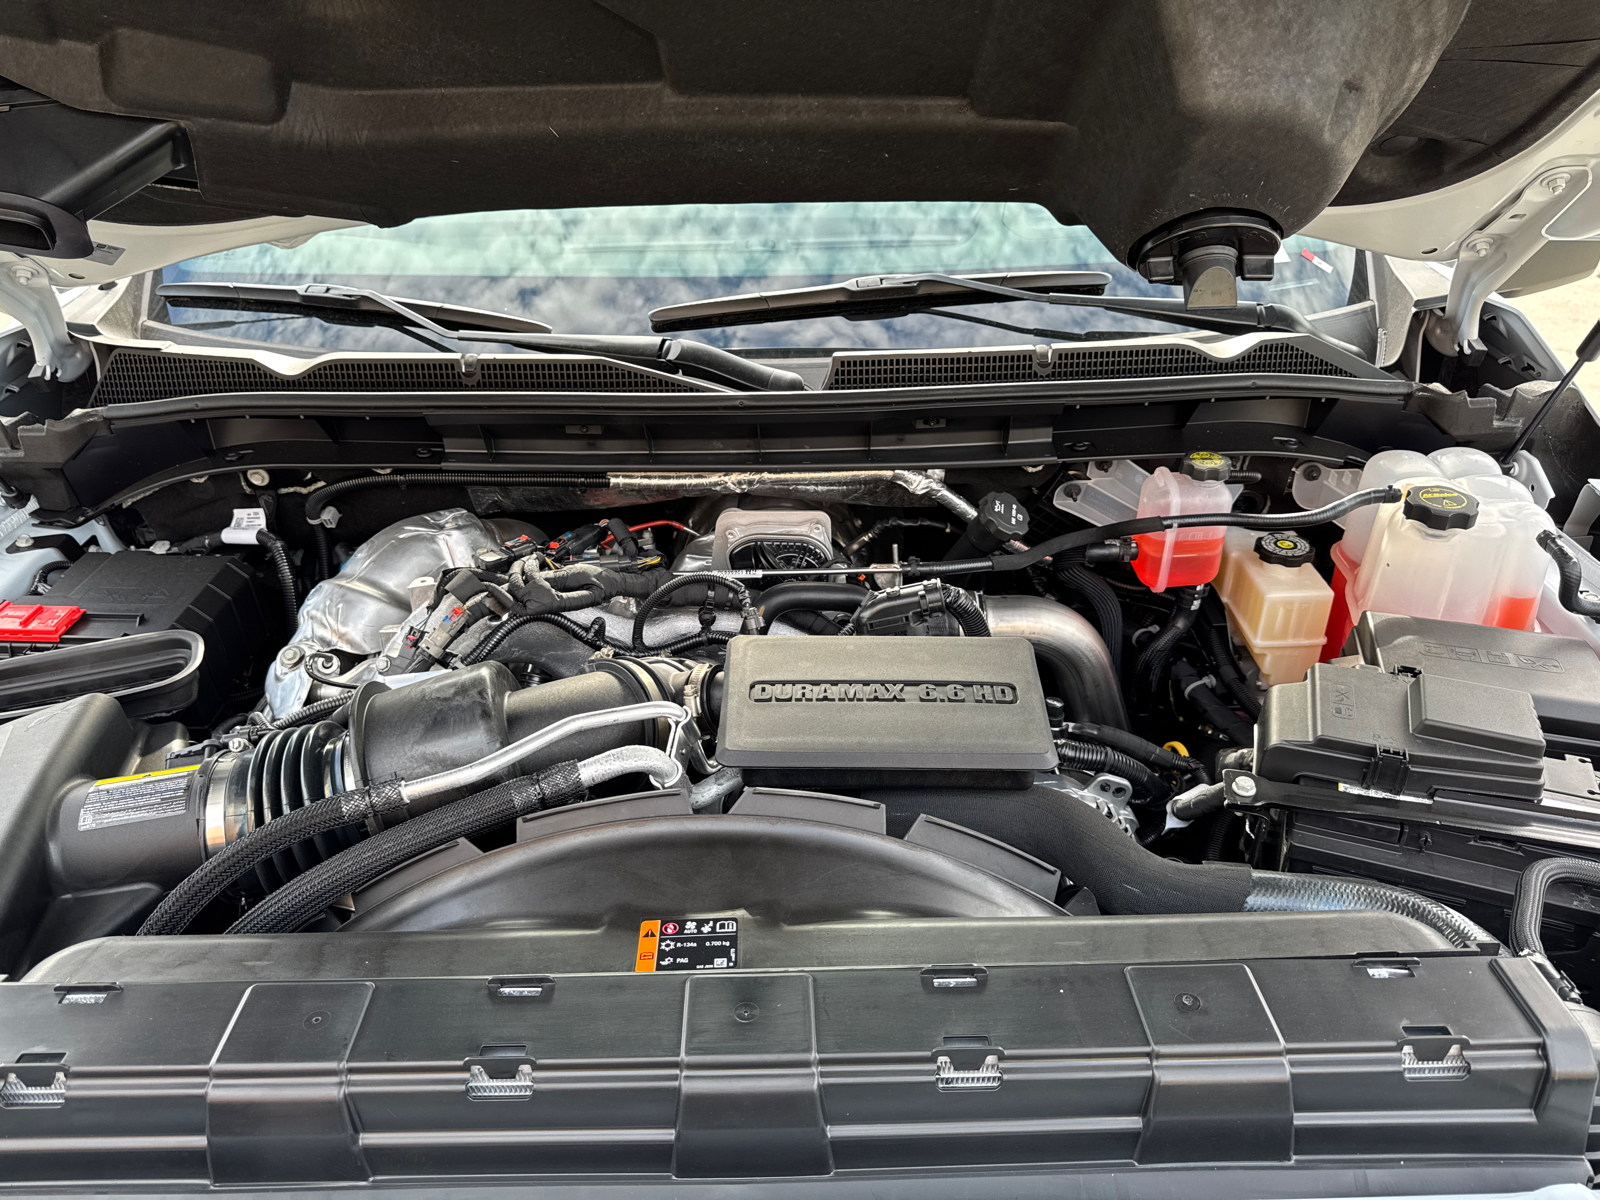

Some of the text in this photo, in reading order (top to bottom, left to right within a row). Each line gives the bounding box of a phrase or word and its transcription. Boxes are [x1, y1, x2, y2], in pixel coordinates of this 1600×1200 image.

[754, 683, 1015, 704] DURAMAX 6.6 HD
